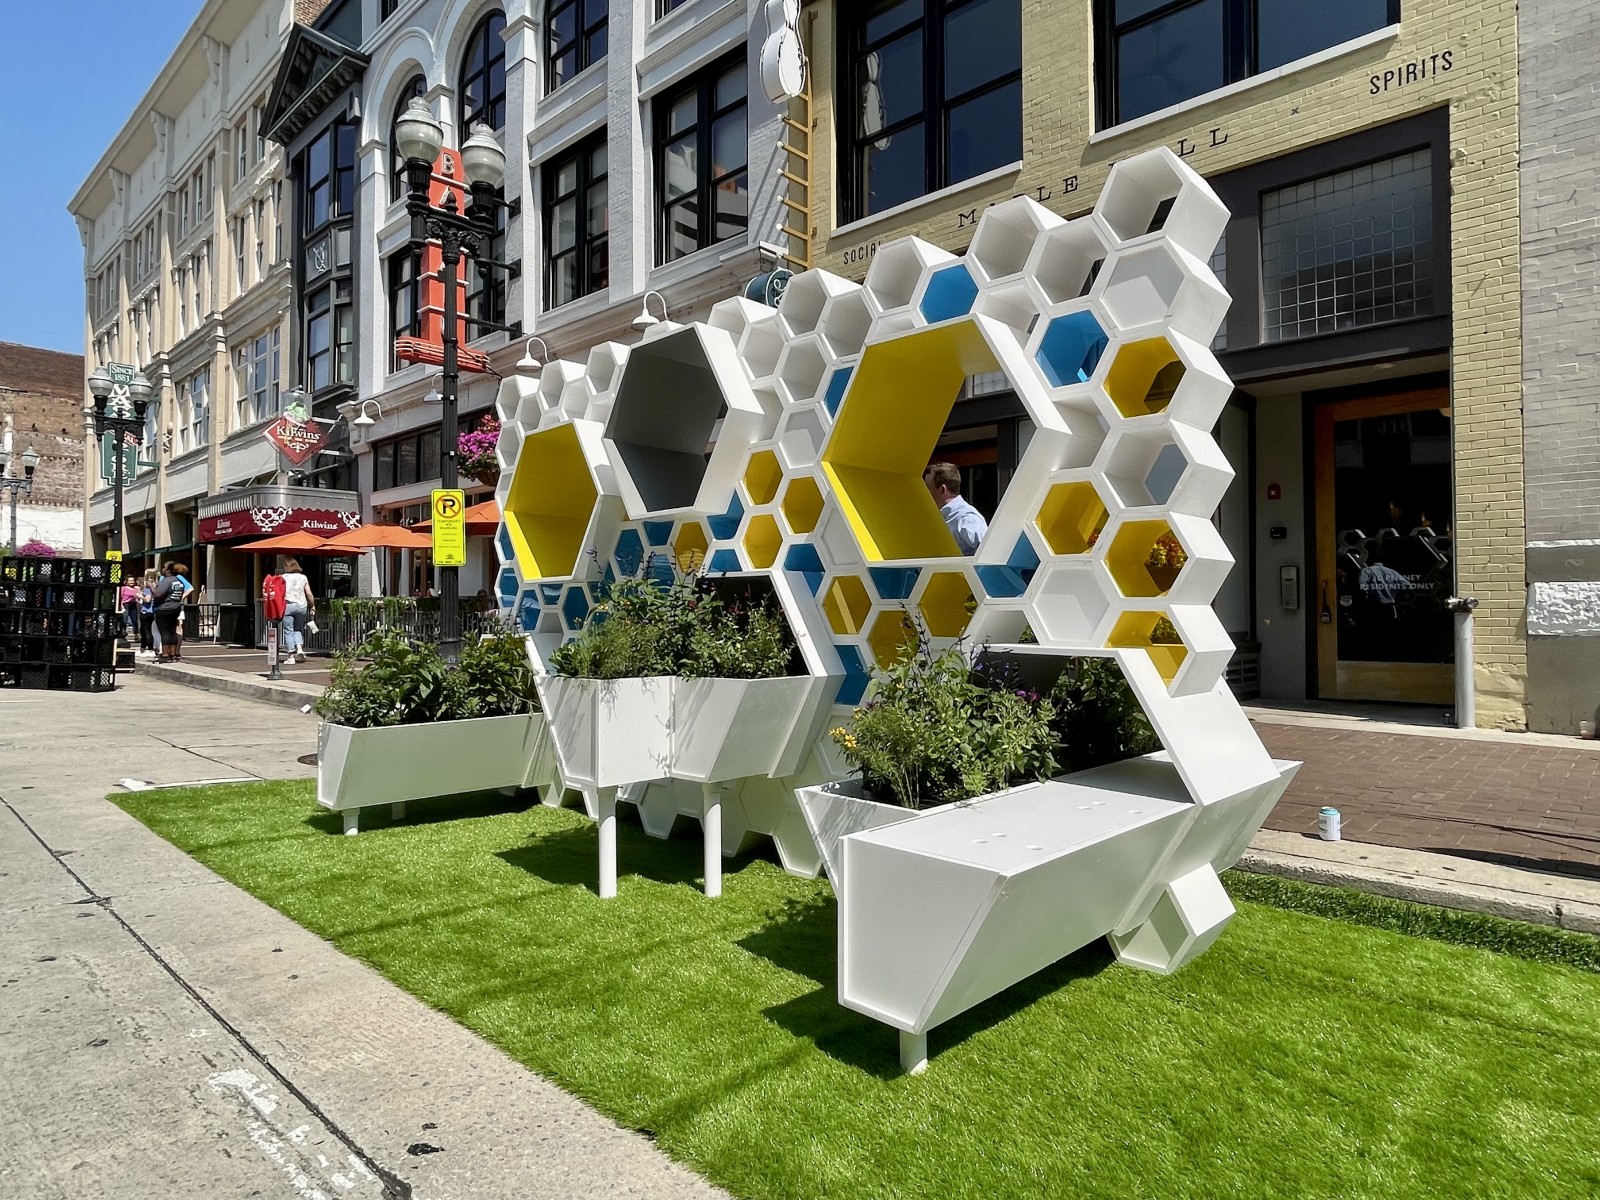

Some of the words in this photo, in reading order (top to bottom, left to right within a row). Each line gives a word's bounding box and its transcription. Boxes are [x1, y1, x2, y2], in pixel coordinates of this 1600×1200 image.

[1369, 51, 1453, 95] SPIRITS
[958, 175, 1079, 229] MLE
[111, 364, 133, 376] SINCE
[114, 373, 130, 383] 1883
[276, 425, 322, 440] Kilwins
[302, 519, 338, 530] Kilwins
